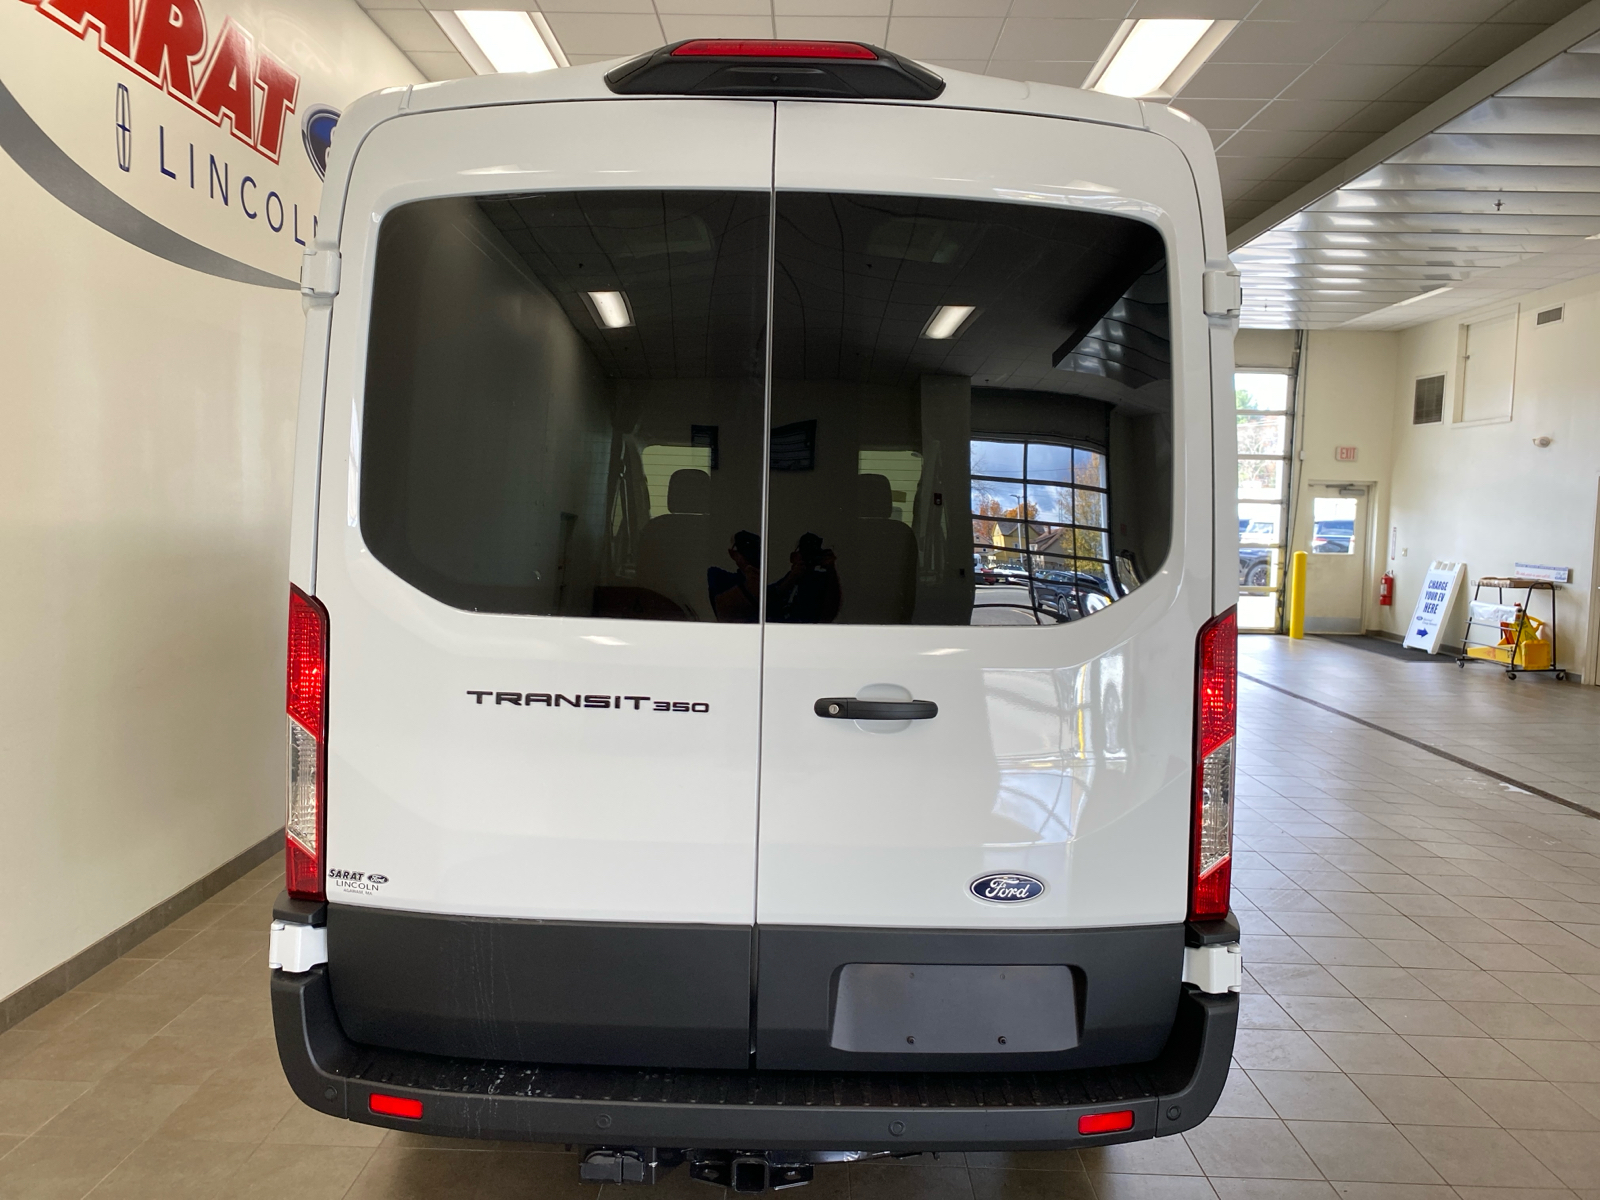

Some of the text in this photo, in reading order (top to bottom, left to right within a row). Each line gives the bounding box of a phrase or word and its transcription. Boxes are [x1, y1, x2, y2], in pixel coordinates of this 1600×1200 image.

[159, 124, 319, 247] LINCOL
[1340, 447, 1356, 460] EXIT
[1427, 579, 1449, 591] CHARGE
[1424, 590, 1446, 602] YOUR EV
[1422, 601, 1439, 614] HERE
[466, 690, 710, 713] TRANSIT 350
[328, 868, 365, 882] SARAT
[336, 880, 379, 891] LINCOLN
[985, 877, 1031, 898] Ford
